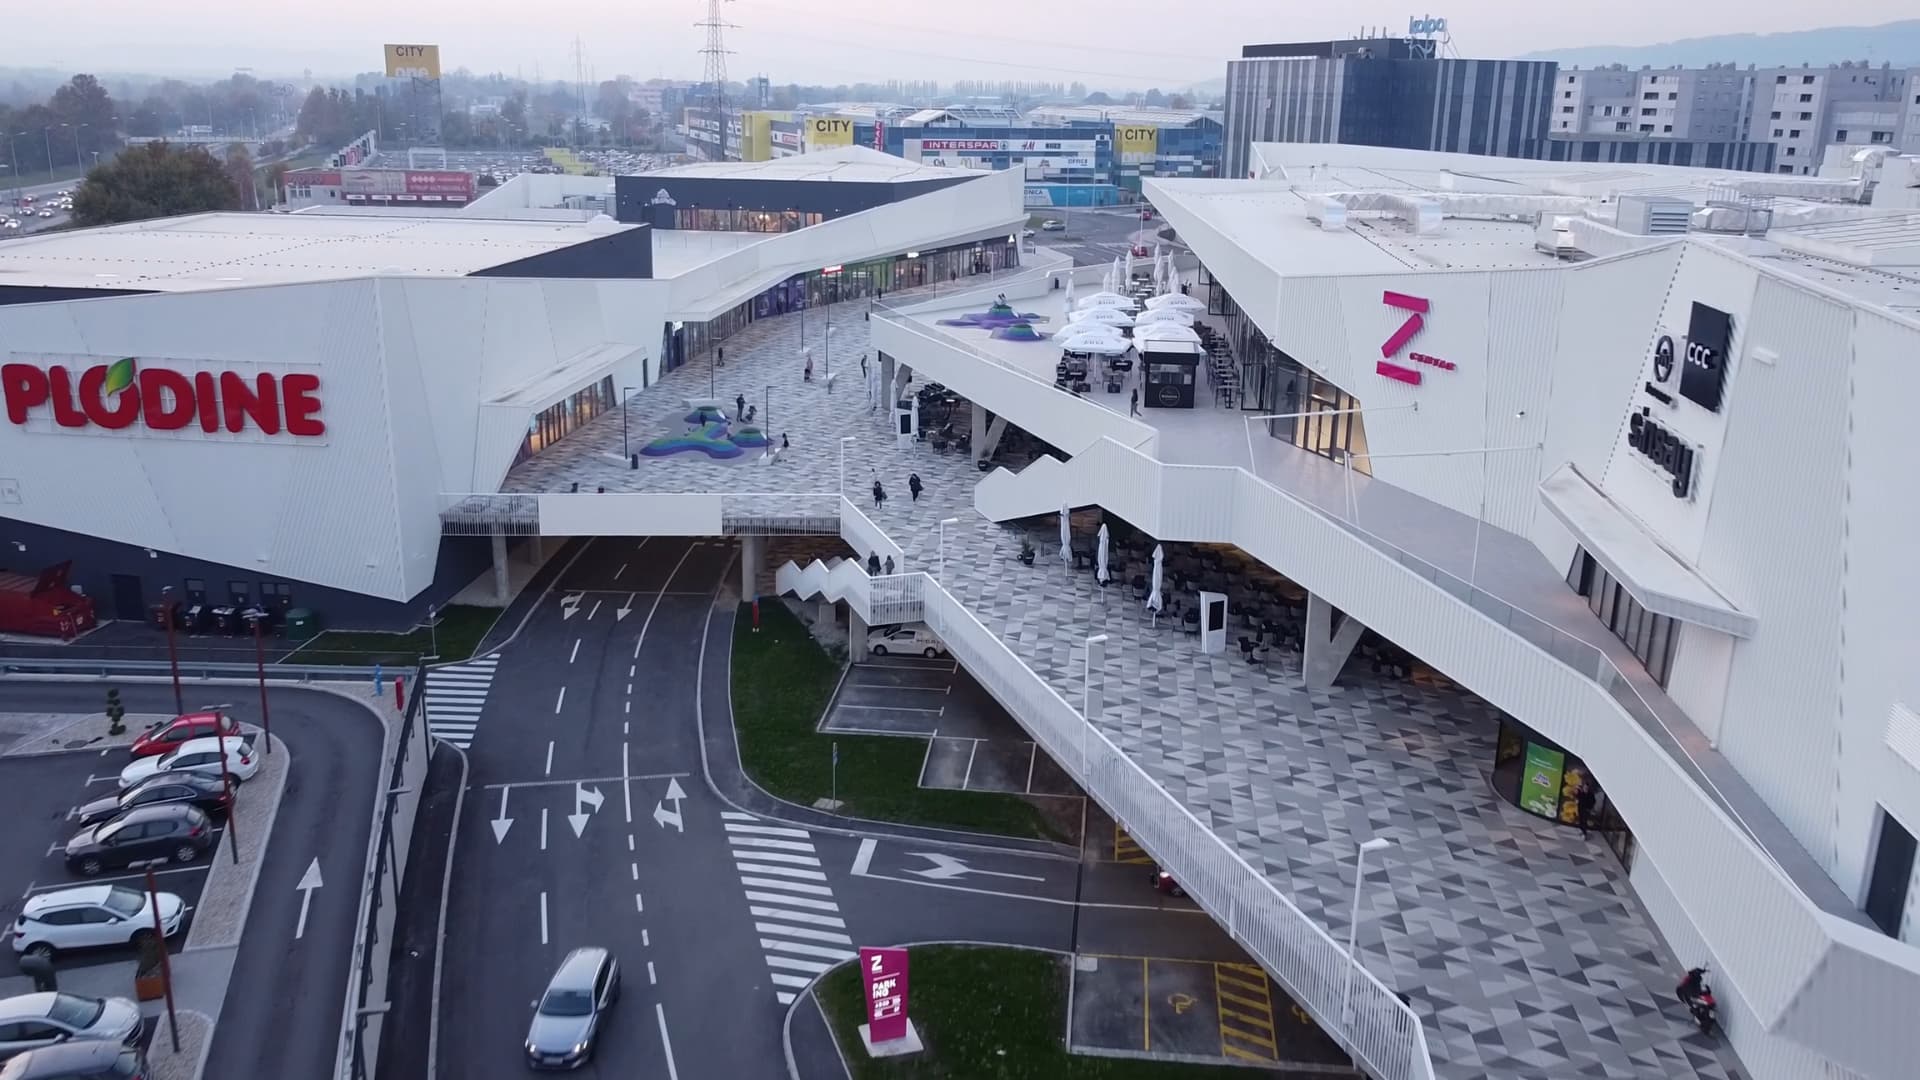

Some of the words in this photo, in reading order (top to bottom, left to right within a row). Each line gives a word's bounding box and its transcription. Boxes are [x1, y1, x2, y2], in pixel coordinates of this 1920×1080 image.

[395, 46, 424, 57] CITY
[816, 119, 850, 133] CITY
[1125, 128, 1155, 141] CITY
[929, 141, 998, 149] INTERSPAR
[1686, 342, 1711, 369] CCC
[1, 357, 325, 436] PLODINE
[1628, 406, 1694, 498] sinsay
